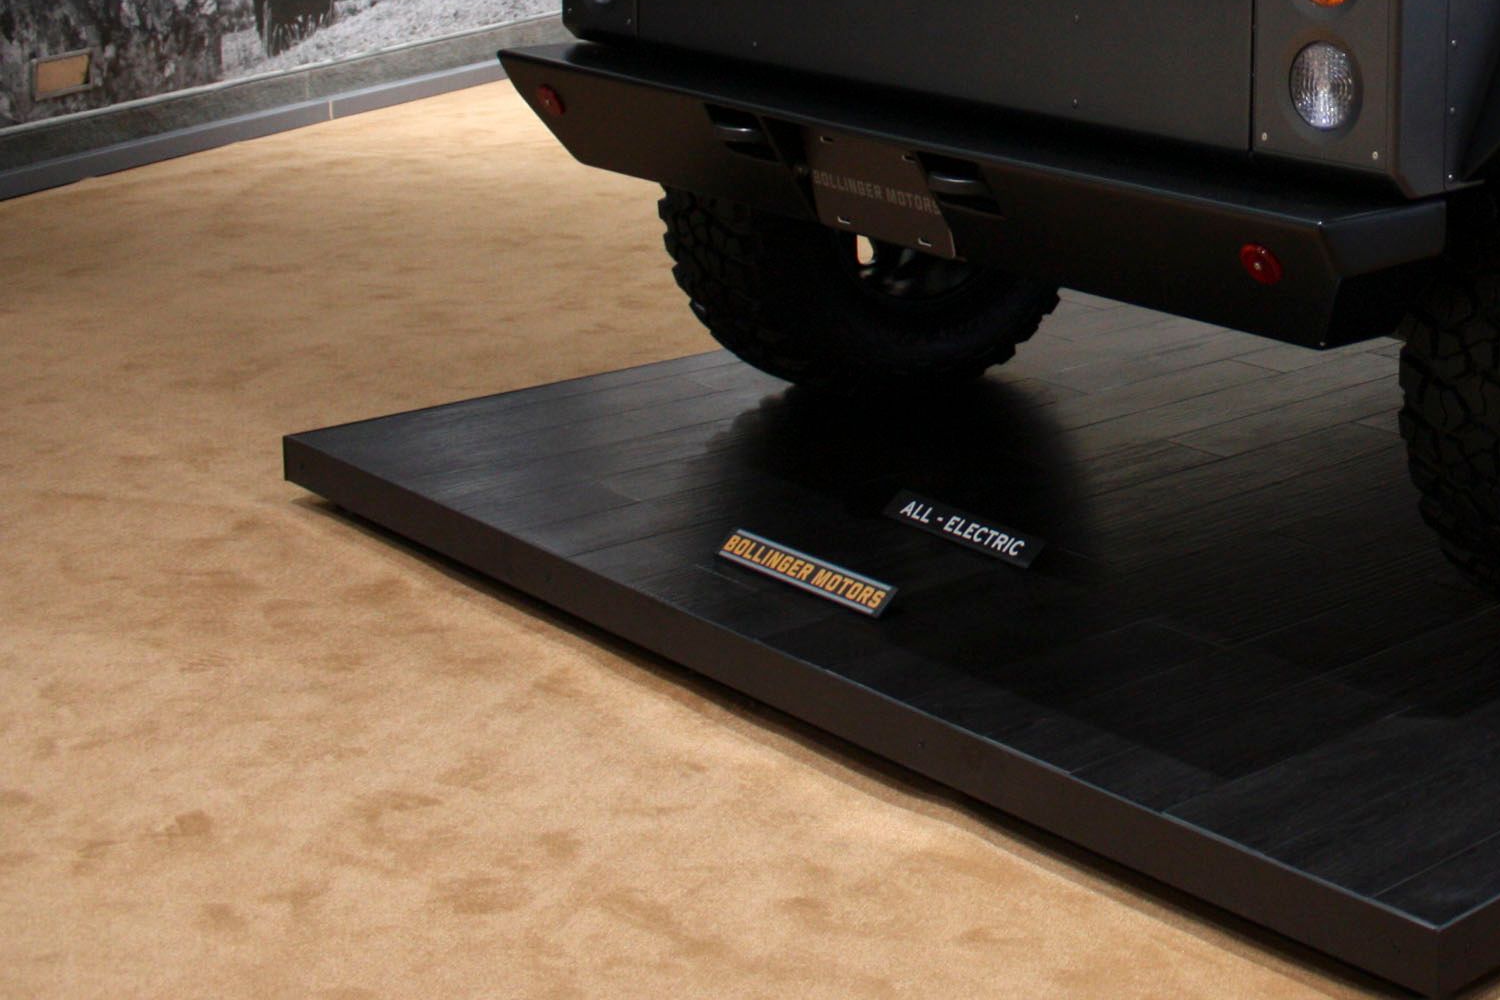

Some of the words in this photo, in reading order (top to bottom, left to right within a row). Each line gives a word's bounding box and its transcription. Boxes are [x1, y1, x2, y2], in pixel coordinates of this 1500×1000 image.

[812, 168, 883, 200] BOLLINGER
[884, 187, 943, 216] MOTORS
[900, 501, 933, 524] ALL
[943, 515, 1026, 556] ELECTRIC
[723, 534, 815, 581] BOLLINGER
[810, 568, 887, 609] MOTORS
